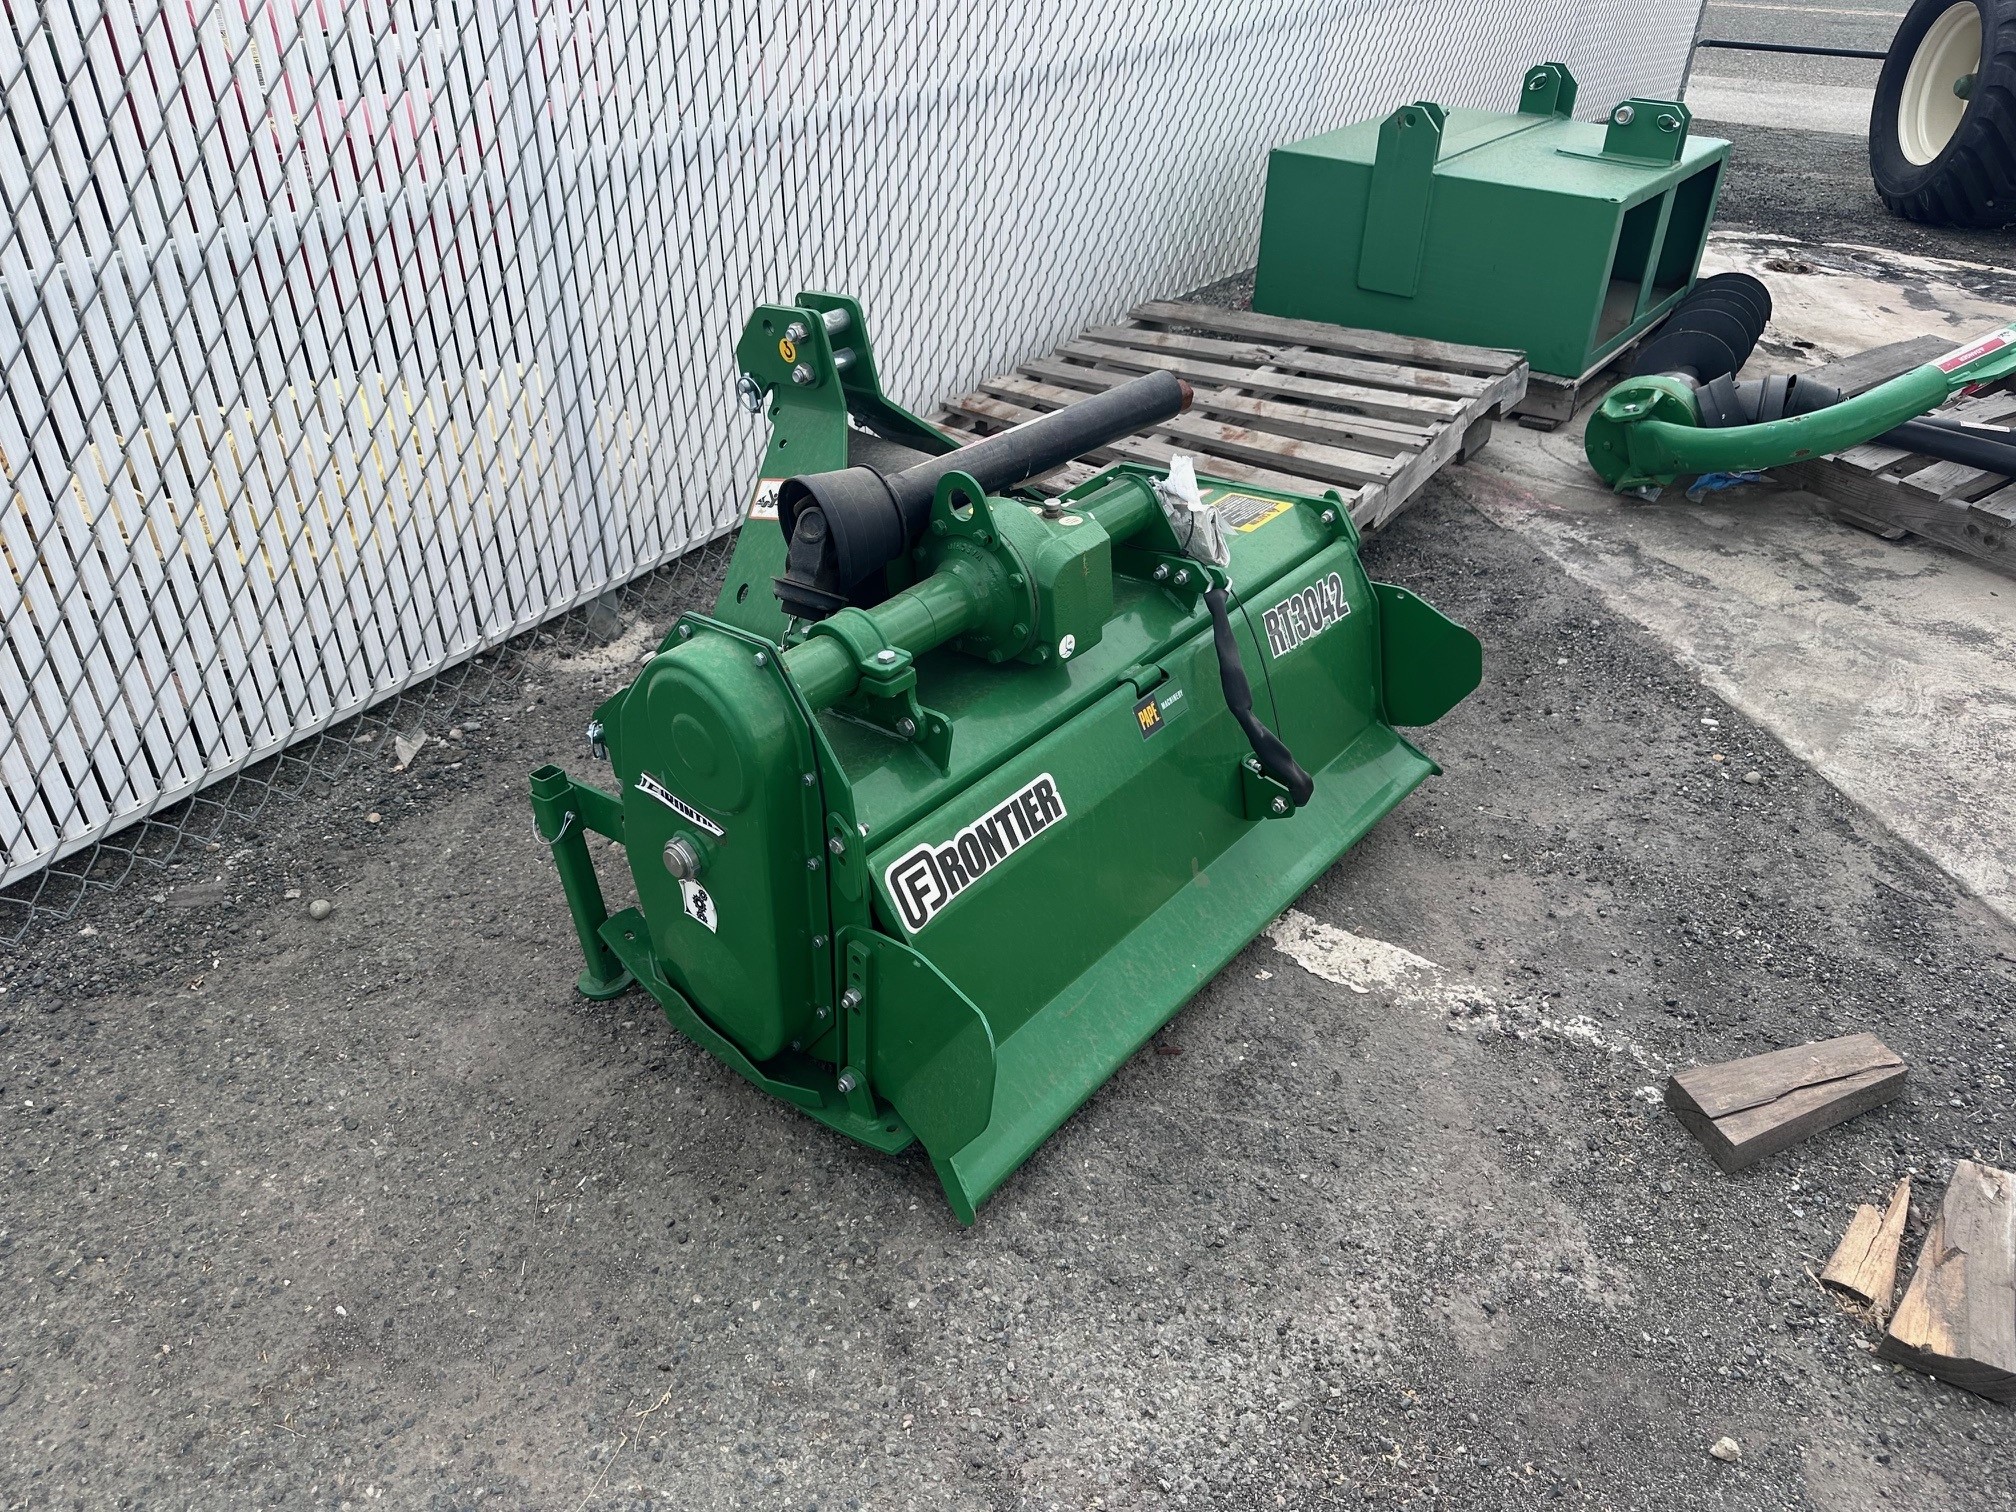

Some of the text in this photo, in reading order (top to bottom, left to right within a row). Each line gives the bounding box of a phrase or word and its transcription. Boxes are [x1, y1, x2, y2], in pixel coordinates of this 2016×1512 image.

[1262, 572, 1351, 658] RT3042
[1161, 689, 1184, 710] MACHINERY
[889, 778, 1064, 930] FRONTIER
